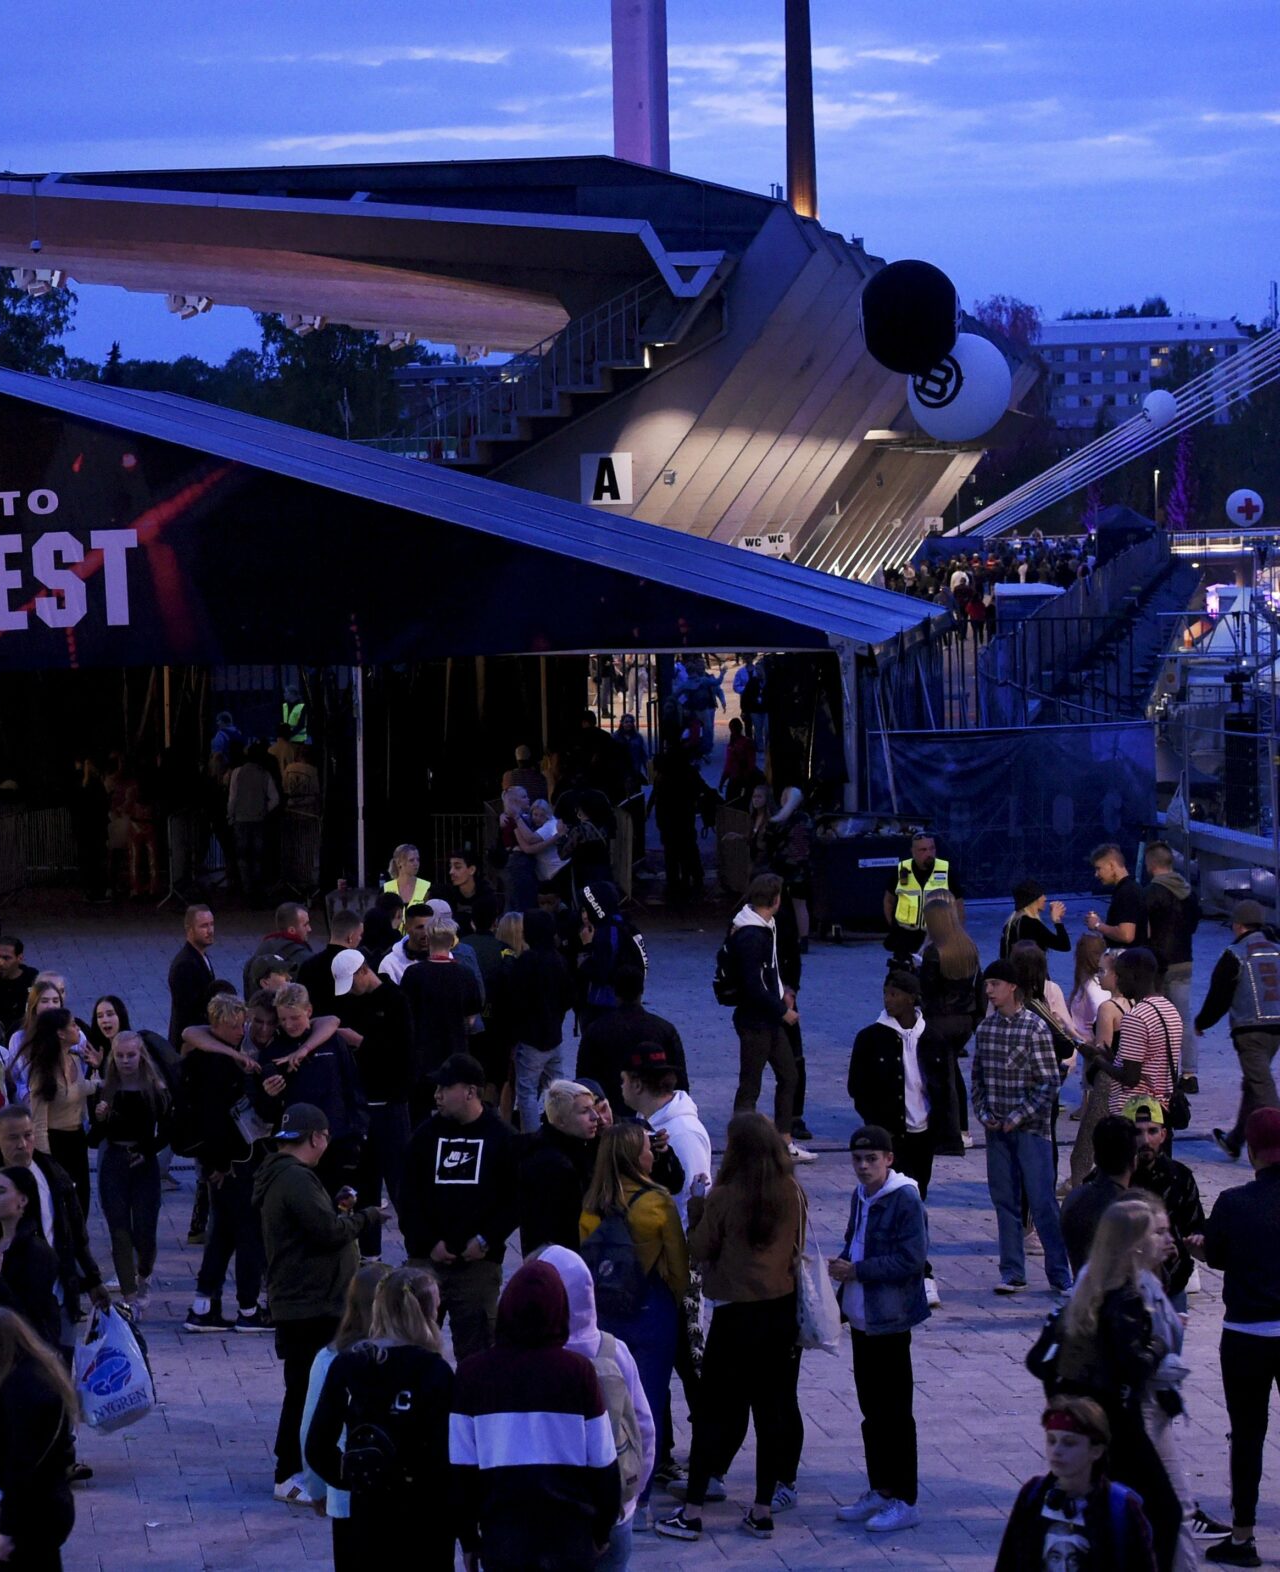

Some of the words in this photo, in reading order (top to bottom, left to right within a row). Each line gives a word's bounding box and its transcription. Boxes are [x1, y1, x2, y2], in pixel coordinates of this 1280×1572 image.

[593, 457, 620, 500] A
[745, 538, 761, 548] WC
[768, 534, 784, 544] WC
[93, 1387, 147, 1422] NYGREN
